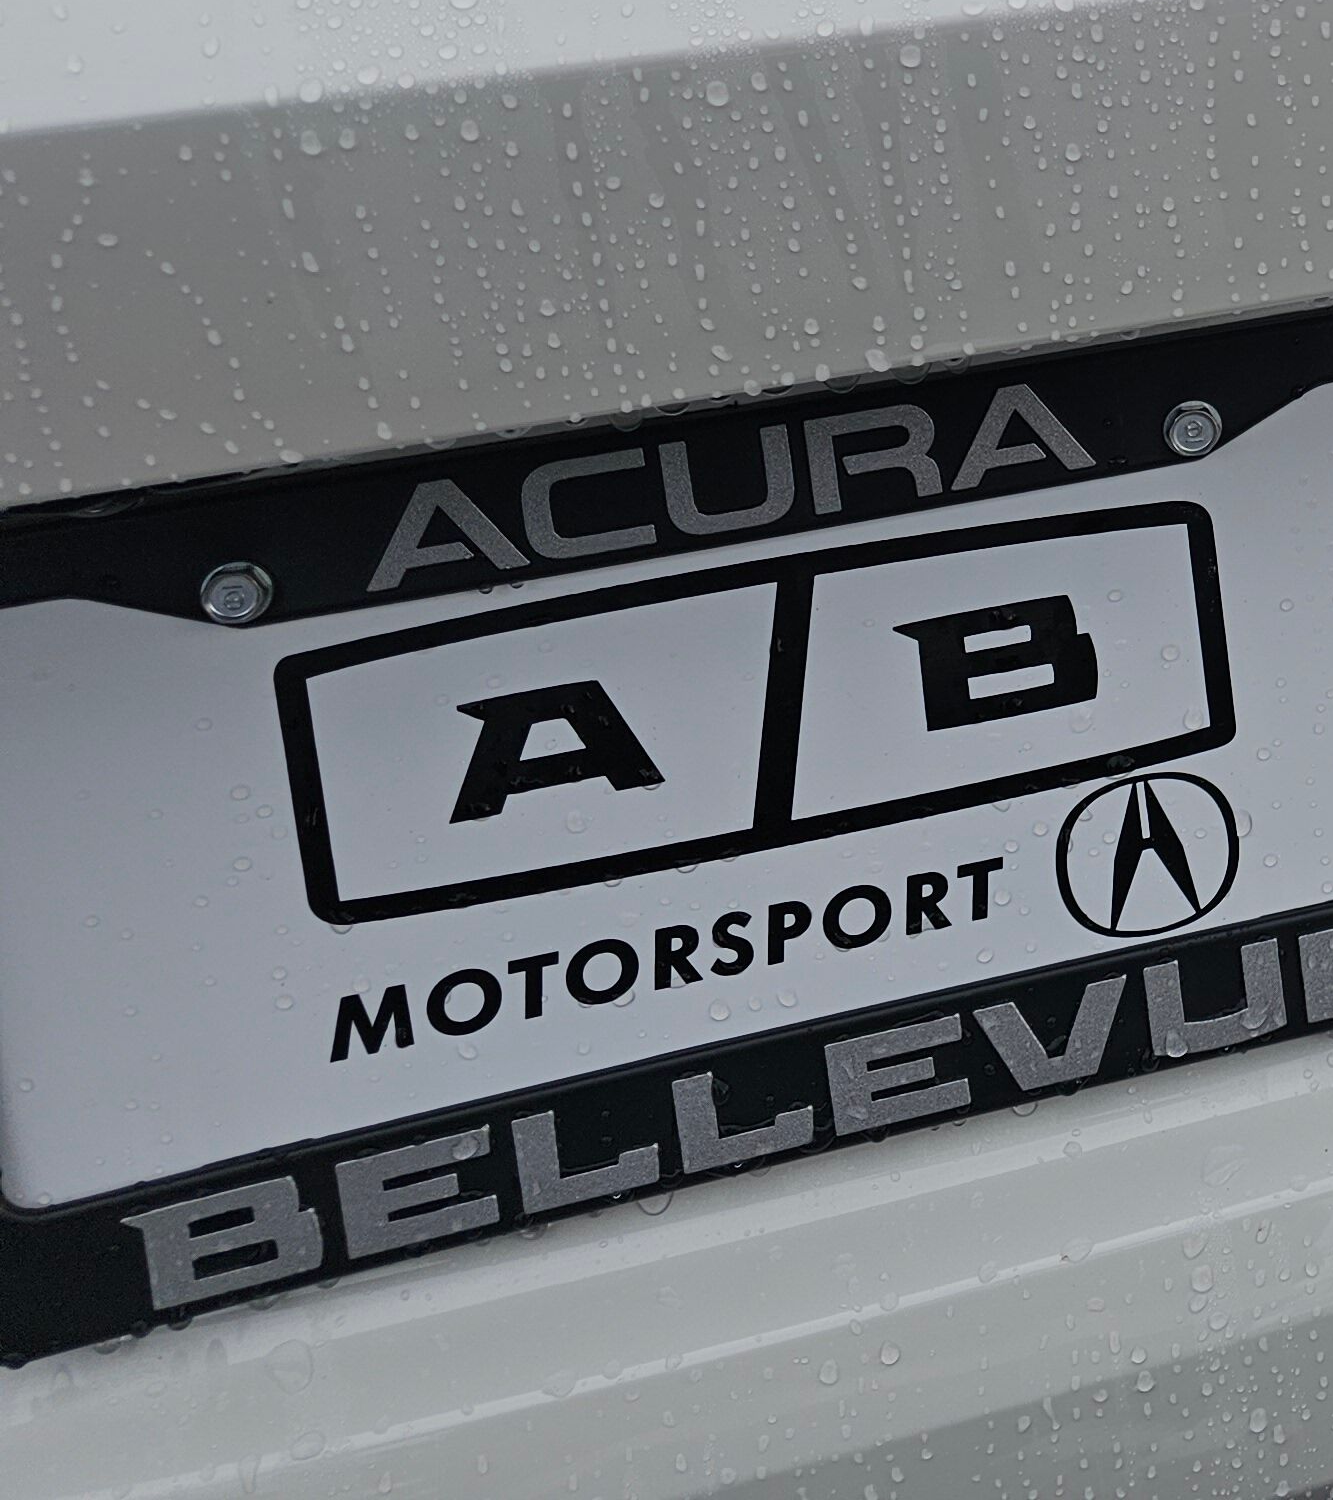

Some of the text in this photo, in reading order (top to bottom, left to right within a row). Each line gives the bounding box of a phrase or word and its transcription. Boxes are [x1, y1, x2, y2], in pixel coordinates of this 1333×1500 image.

[369, 383, 1097, 591] ACURA
[450, 595, 1098, 825] A B
[330, 859, 1004, 1062] MOTORSPORT
